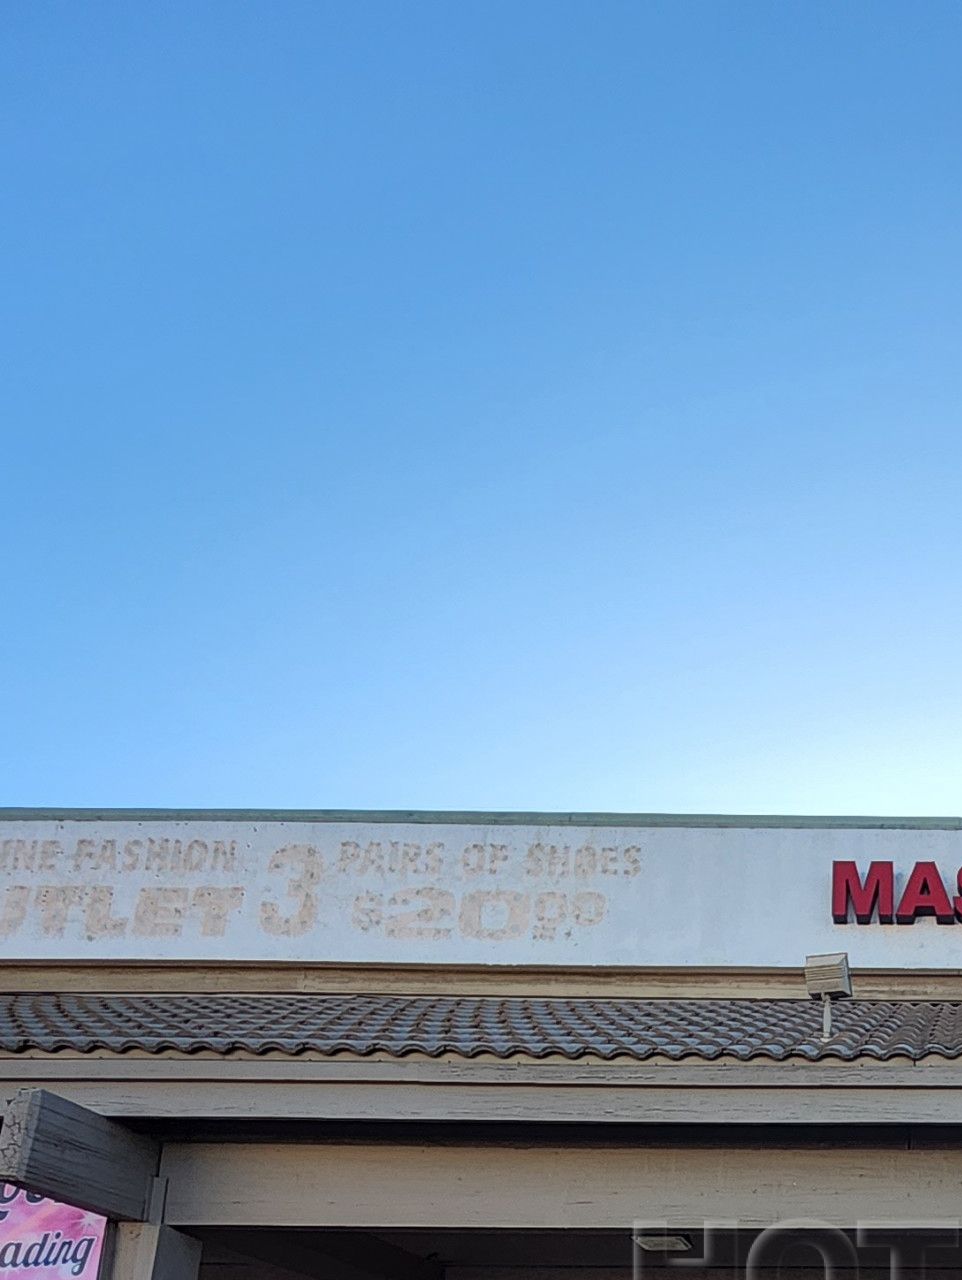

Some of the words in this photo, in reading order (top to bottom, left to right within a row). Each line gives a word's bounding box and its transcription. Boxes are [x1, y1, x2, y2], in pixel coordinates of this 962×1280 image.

[73, 838, 238, 872] FASHION
[335, 841, 445, 875] PAIRS
[461, 843, 508, 875] OF
[526, 843, 643, 878] SHOES
[259, 841, 324, 938] 3
